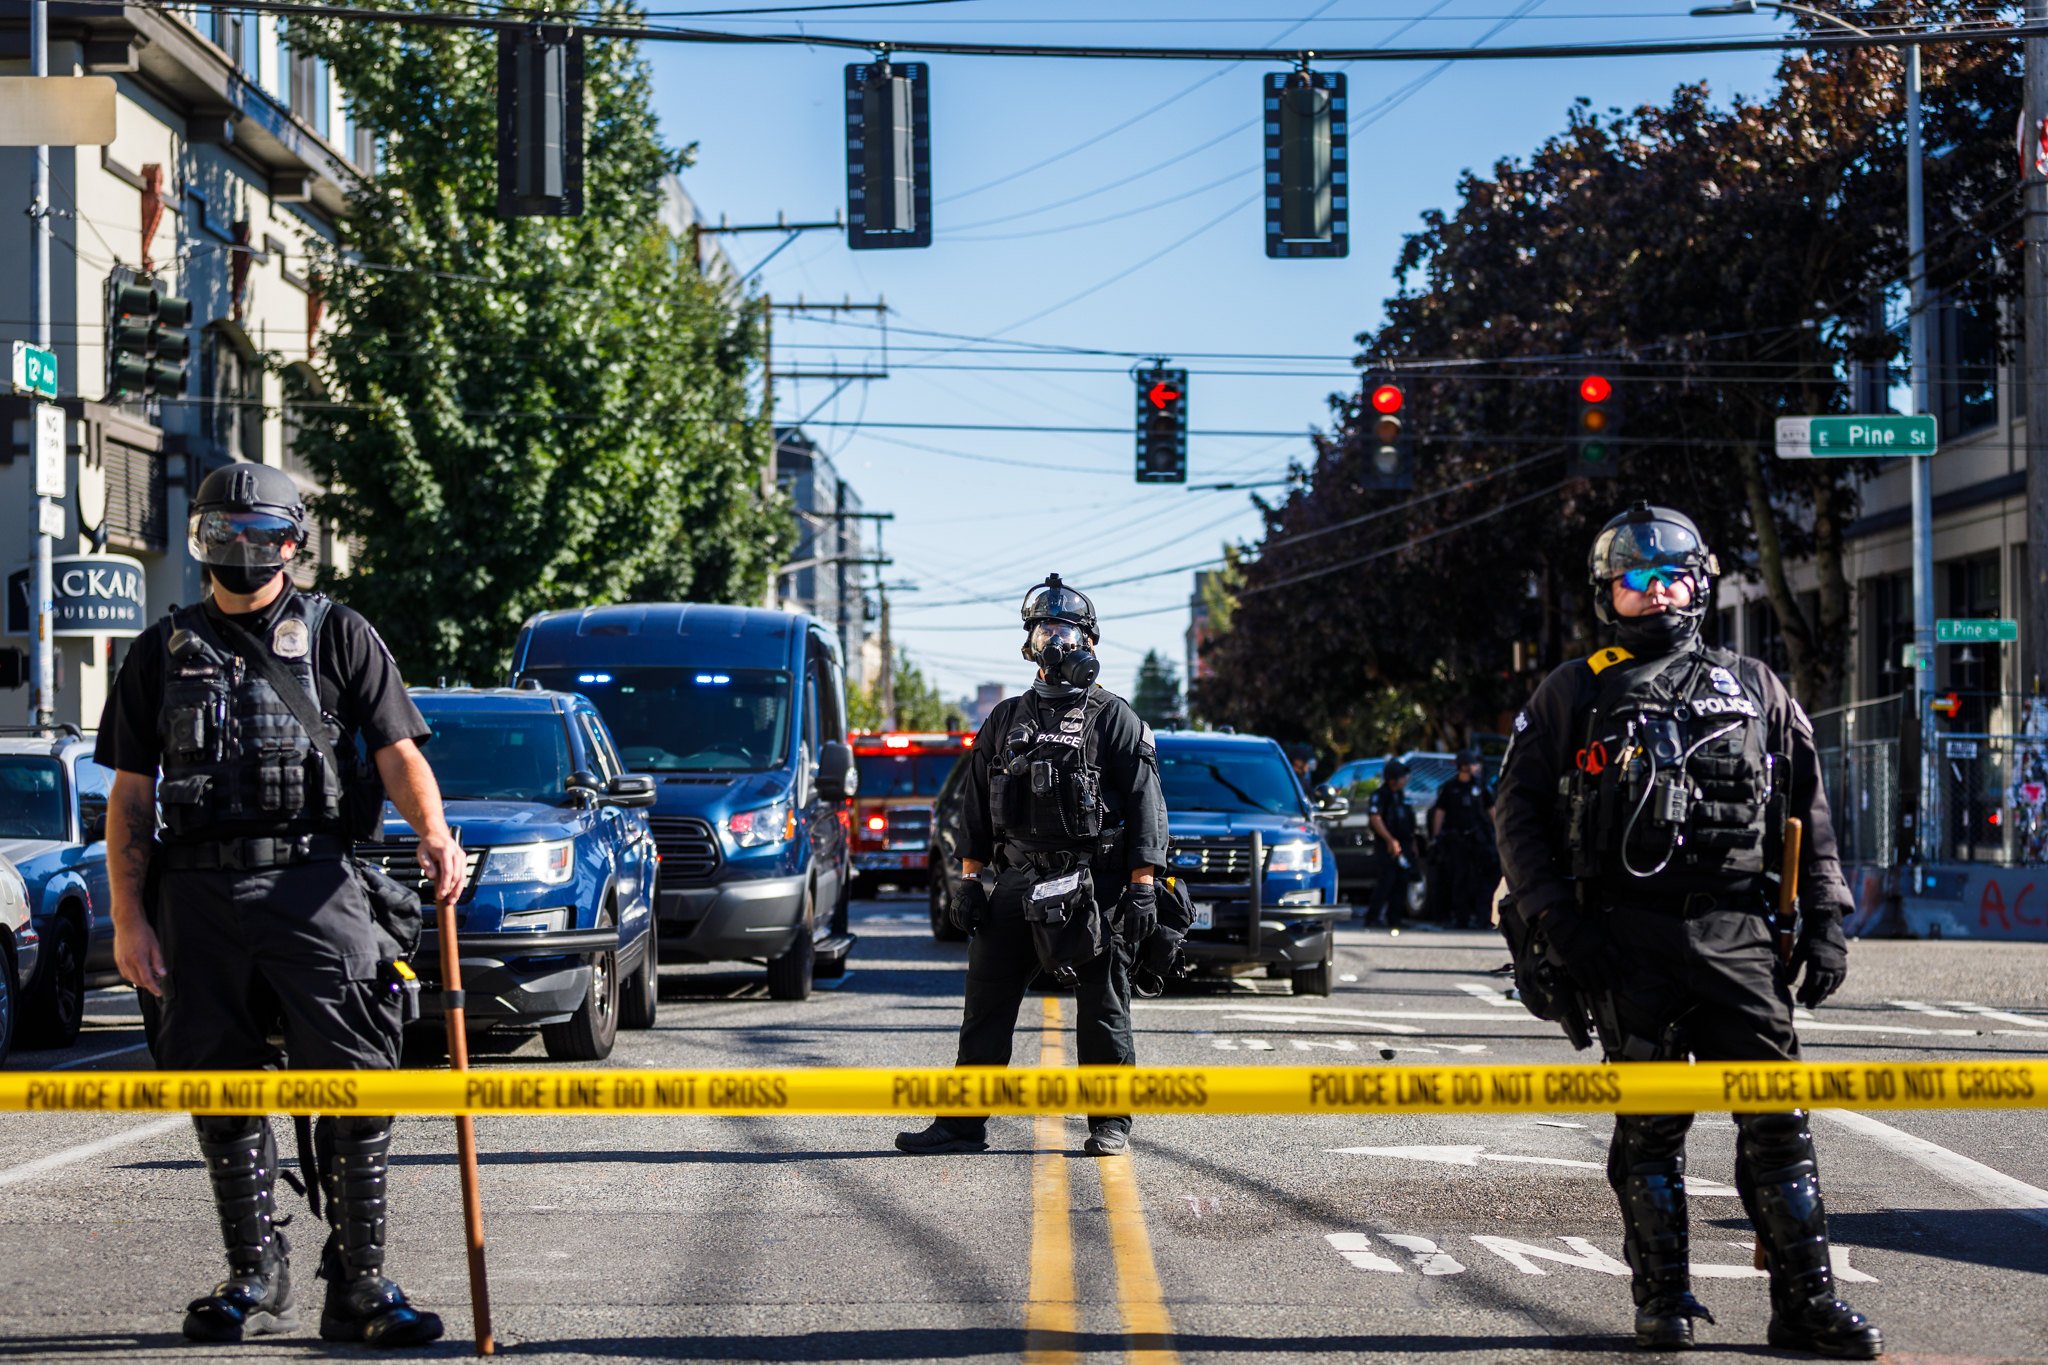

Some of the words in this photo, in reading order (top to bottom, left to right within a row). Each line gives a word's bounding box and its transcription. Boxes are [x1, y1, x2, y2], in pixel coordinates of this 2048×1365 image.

[1819, 432, 1829, 446] E
[1850, 425, 1895, 446] Pine
[1910, 430, 1926, 446] St
[1953, 621, 1982, 637] Pine
[1692, 698, 1758, 717] POLICE
[1036, 733, 1082, 748] POLICE
[26, 1079, 109, 1110] POLICE
[118, 1079, 171, 1109] LINE
[178, 1079, 212, 1109] DO
[221, 1079, 267, 1109] NOT
[276, 1079, 358, 1109] CROSS
[465, 1078, 547, 1109] POLICE
[555, 1078, 603, 1109] LINE
[613, 1078, 646, 1109] DO
[654, 1078, 699, 1109] NOT
[707, 1077, 788, 1109] CROSS
[892, 1075, 972, 1108] POLICE
[979, 1075, 1029, 1108] LINE
[1037, 1075, 1068, 1108] DO
[1076, 1075, 1121, 1108] NOT
[1129, 1074, 1208, 1107] CROSS
[1309, 1072, 1388, 1106] POLICE
[1396, 1073, 1445, 1105] LINE
[1452, 1073, 1484, 1105] DO
[1491, 1072, 1535, 1105] NOT
[1544, 1071, 1622, 1104] CROSS
[1722, 1069, 1802, 1102] POLICE
[1809, 1069, 1854, 1101] LINE
[1864, 1069, 1897, 1101] DO
[1903, 1069, 1945, 1101] NOT
[1956, 1068, 2036, 1100] CROSS
